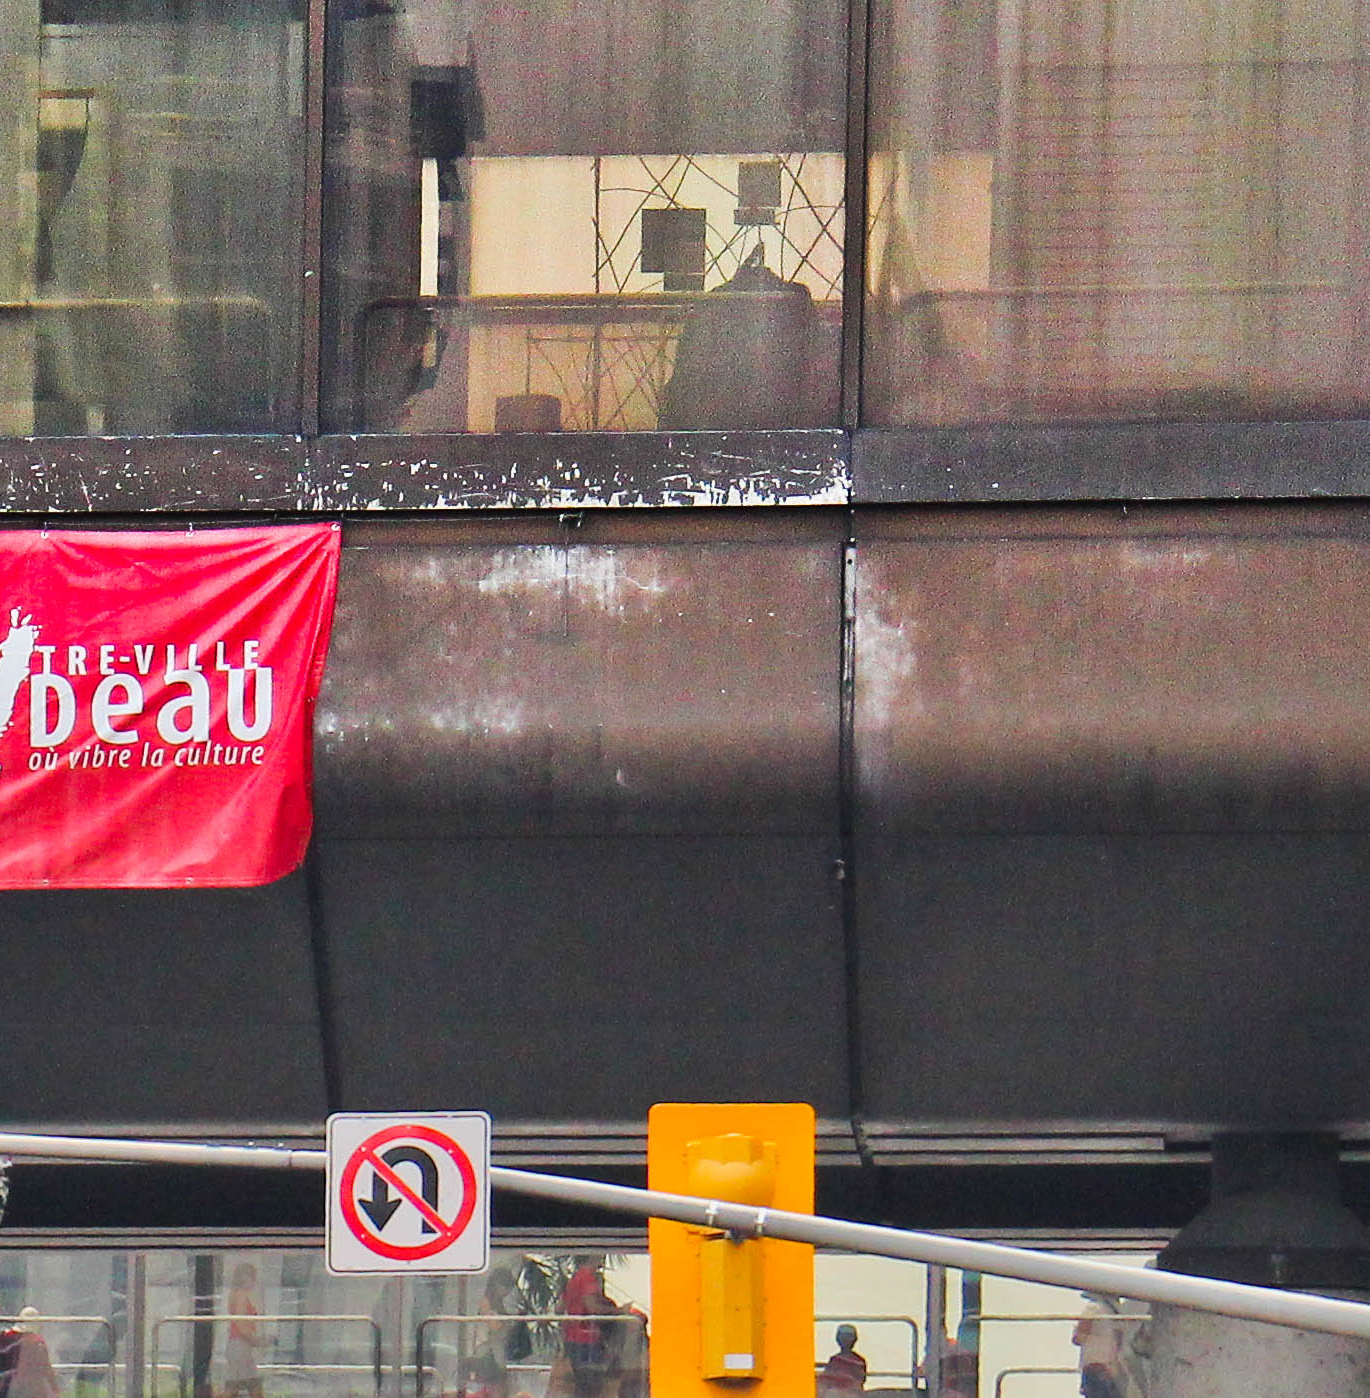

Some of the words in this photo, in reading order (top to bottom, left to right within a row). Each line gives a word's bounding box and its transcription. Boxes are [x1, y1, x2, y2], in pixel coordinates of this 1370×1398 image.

[28, 746, 58, 771] où
[68, 746, 130, 770] vibre
[142, 744, 163, 768] la
[173, 740, 265, 766] culture
